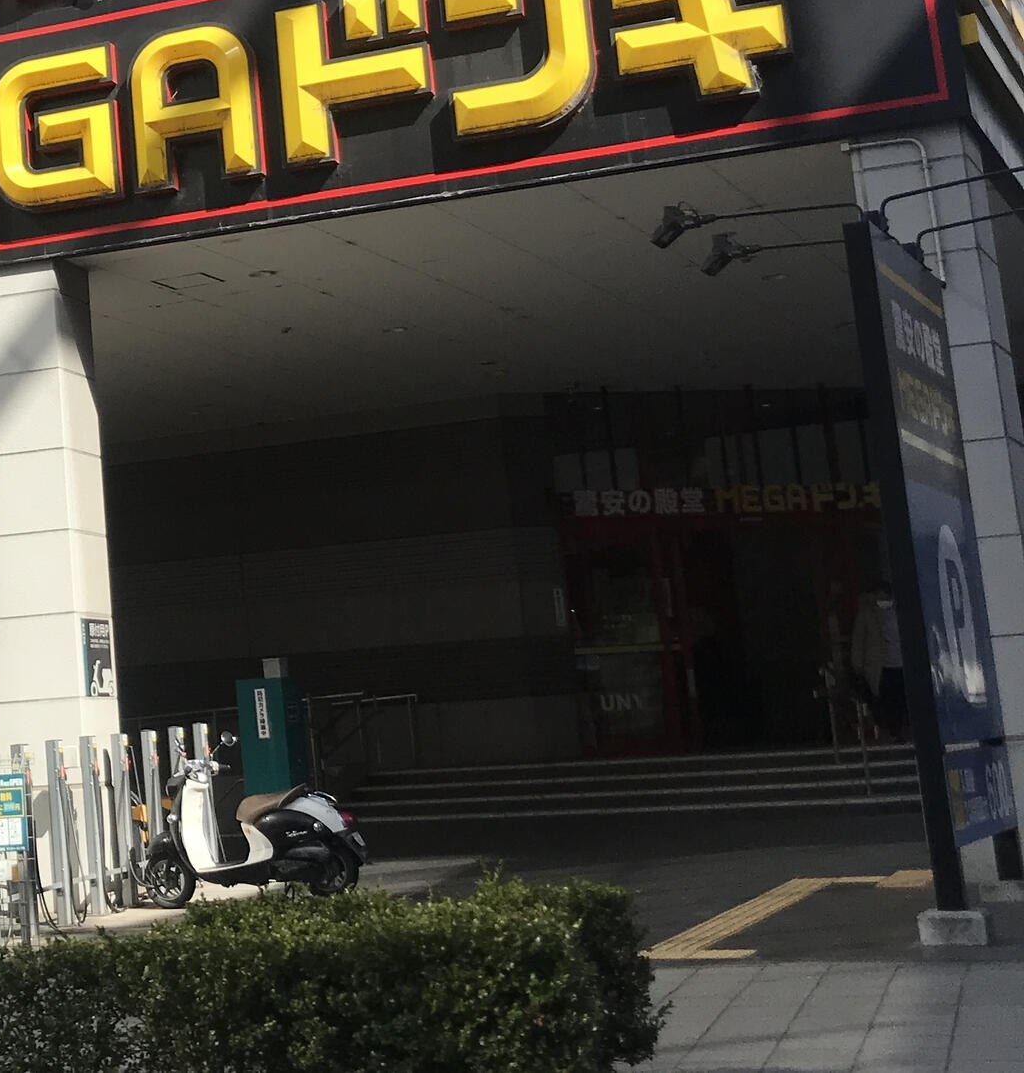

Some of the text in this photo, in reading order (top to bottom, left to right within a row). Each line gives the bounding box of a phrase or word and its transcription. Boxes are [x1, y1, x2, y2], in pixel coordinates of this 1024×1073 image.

[574, 487, 706, 517] 驚安の殿堂
